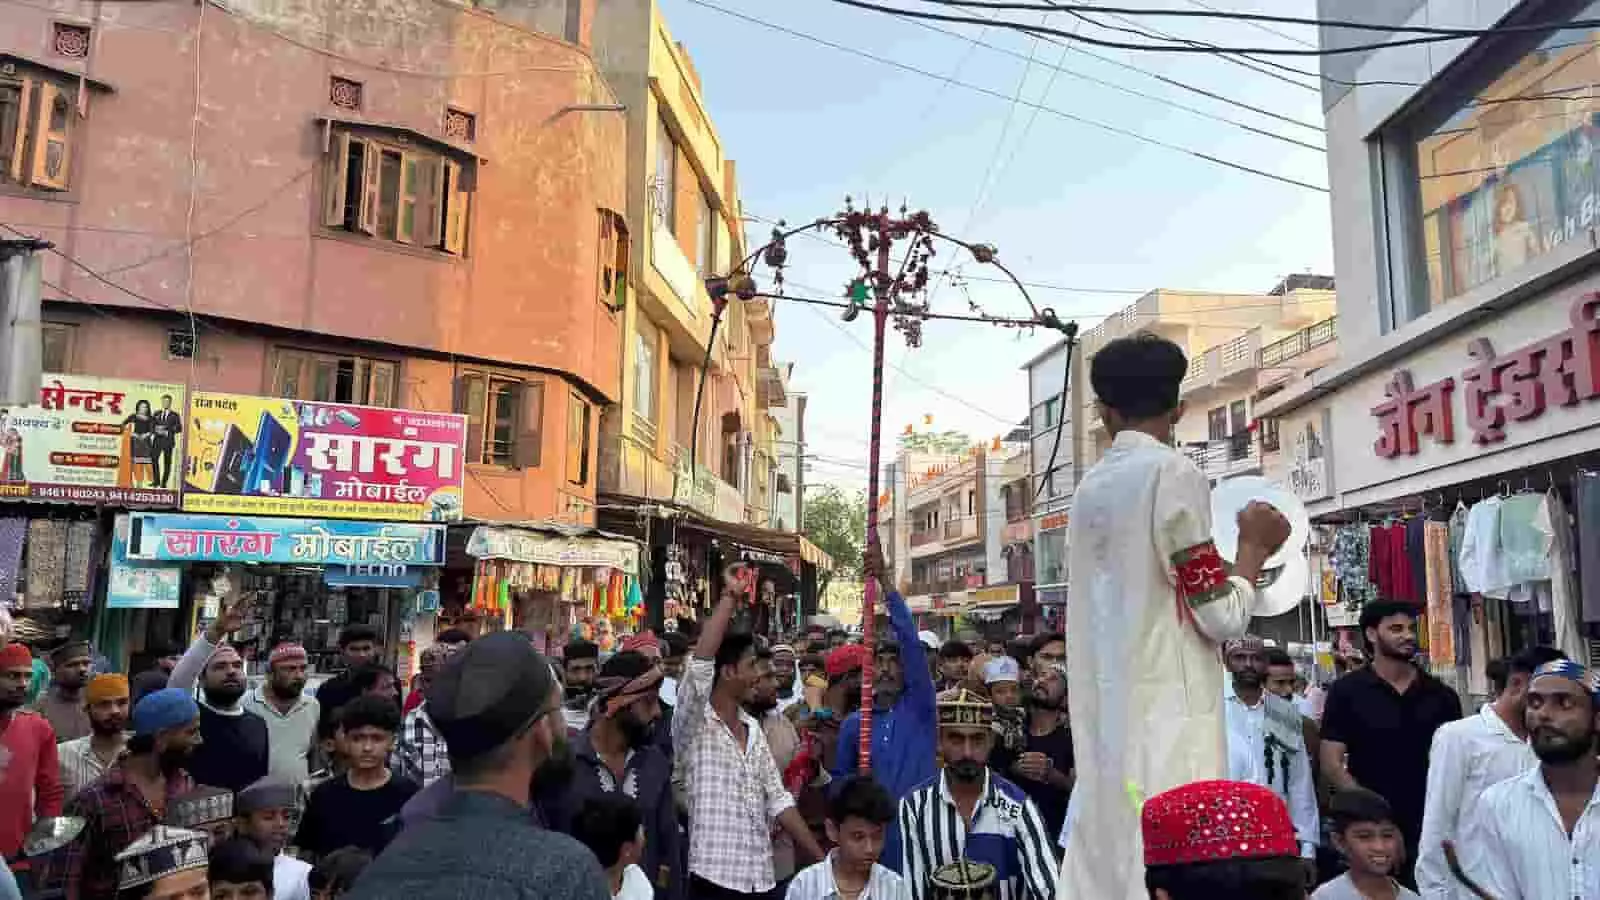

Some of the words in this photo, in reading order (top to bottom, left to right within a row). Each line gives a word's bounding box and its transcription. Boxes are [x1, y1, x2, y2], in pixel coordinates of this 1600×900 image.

[1370, 367, 1456, 458] जैन
[304, 426, 459, 479] सारंग
[332, 476, 430, 503] मोबाईल
[160, 519, 280, 557] सारंग
[289, 525, 418, 561] मोबाईल
